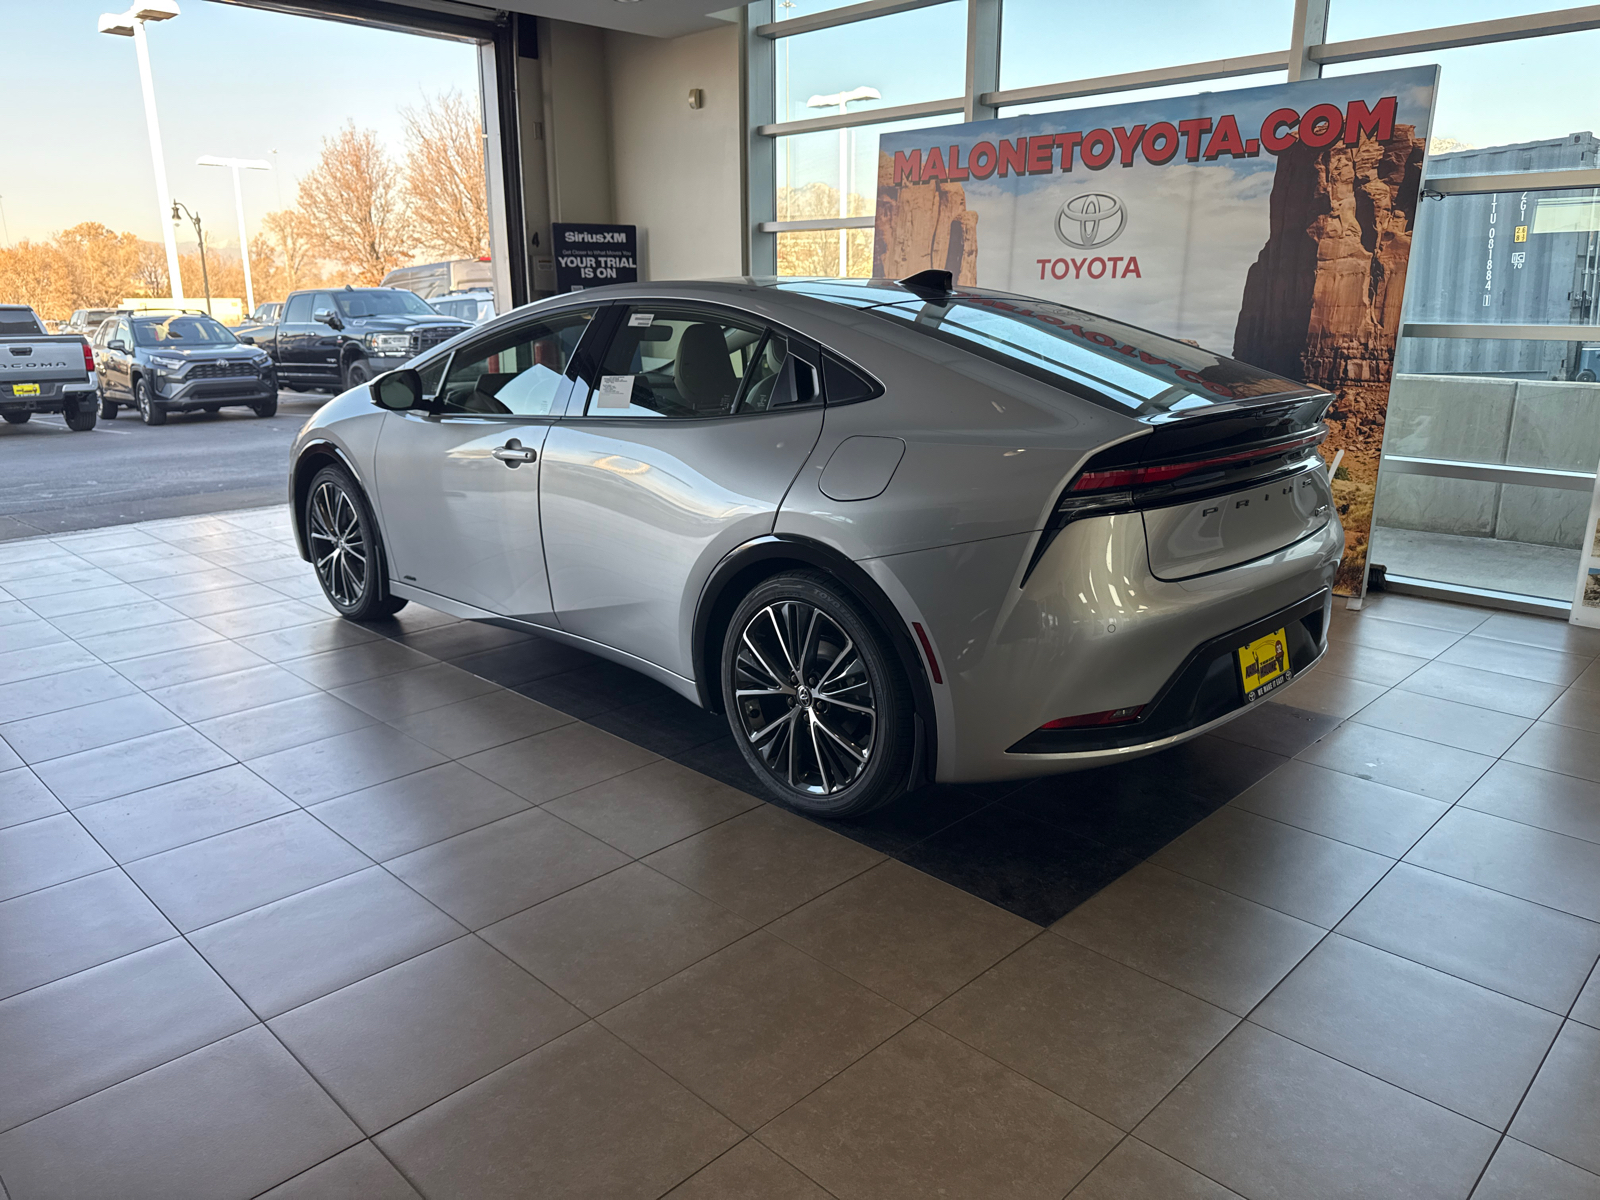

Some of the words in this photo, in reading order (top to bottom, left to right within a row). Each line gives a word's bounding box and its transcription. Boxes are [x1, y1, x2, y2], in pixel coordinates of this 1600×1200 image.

[893, 96, 1398, 185] MALONETOYOTA.COM
[564, 232, 626, 243] SiriusXM
[558, 257, 596, 268] YOUR
[598, 257, 637, 268] TRIAL
[1036, 256, 1142, 281] TOYOTA
[581, 268, 594, 278] IS
[596, 268, 617, 278] ON
[1202, 478, 1312, 517] PRIUS
